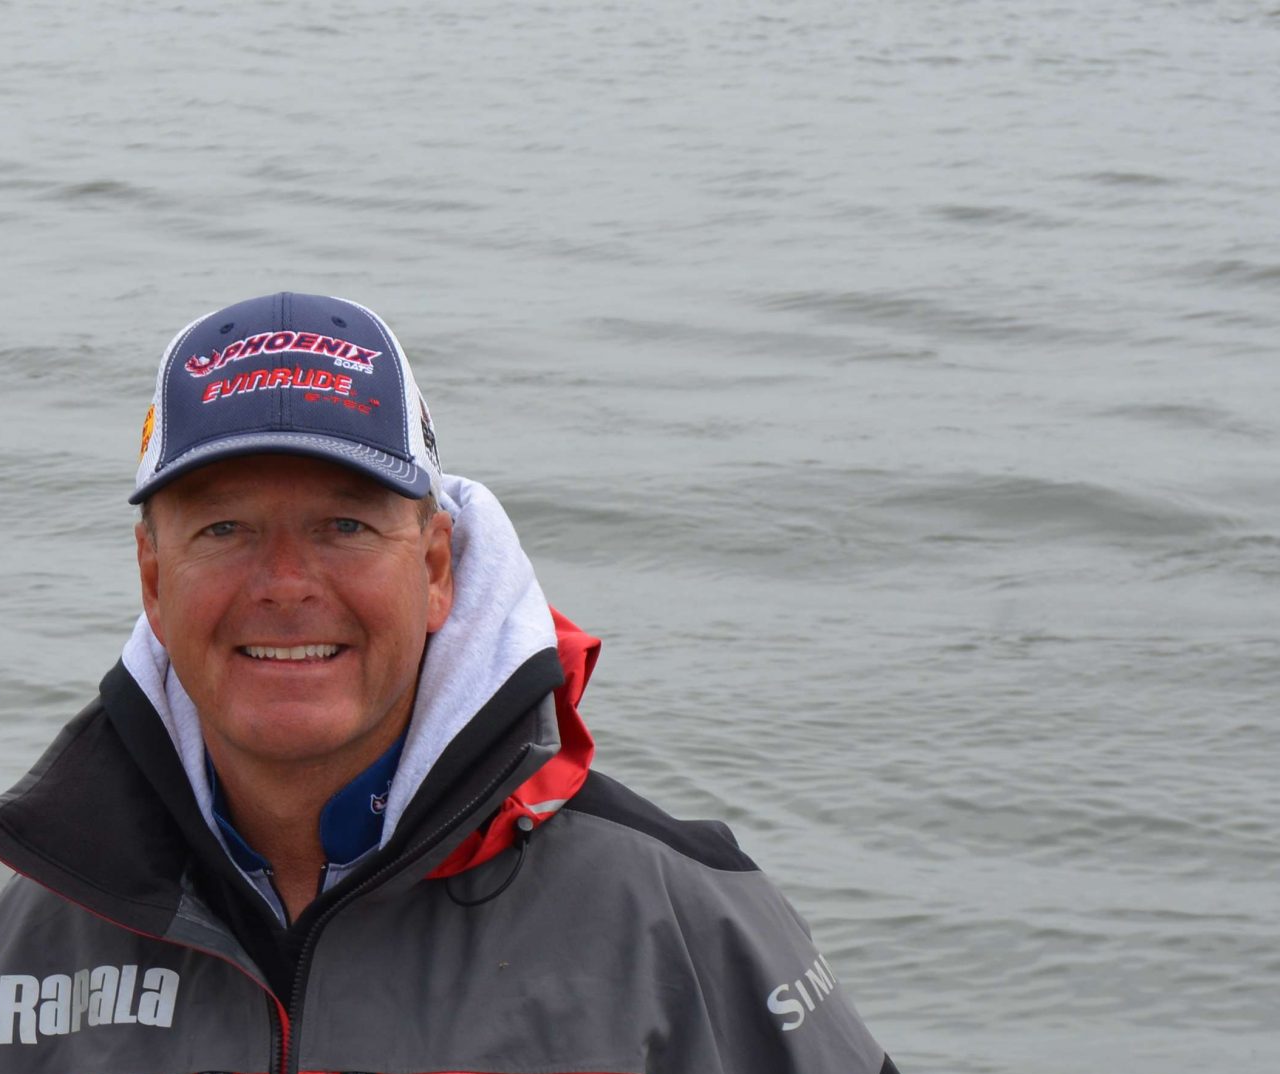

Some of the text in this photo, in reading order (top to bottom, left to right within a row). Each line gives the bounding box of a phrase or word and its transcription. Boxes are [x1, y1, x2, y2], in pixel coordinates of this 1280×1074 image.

[213, 331, 382, 370] PHOENIX
[334, 359, 375, 375] BOATS
[202, 366, 353, 404] EVINRUDE
[766, 953, 836, 1031] SIM
